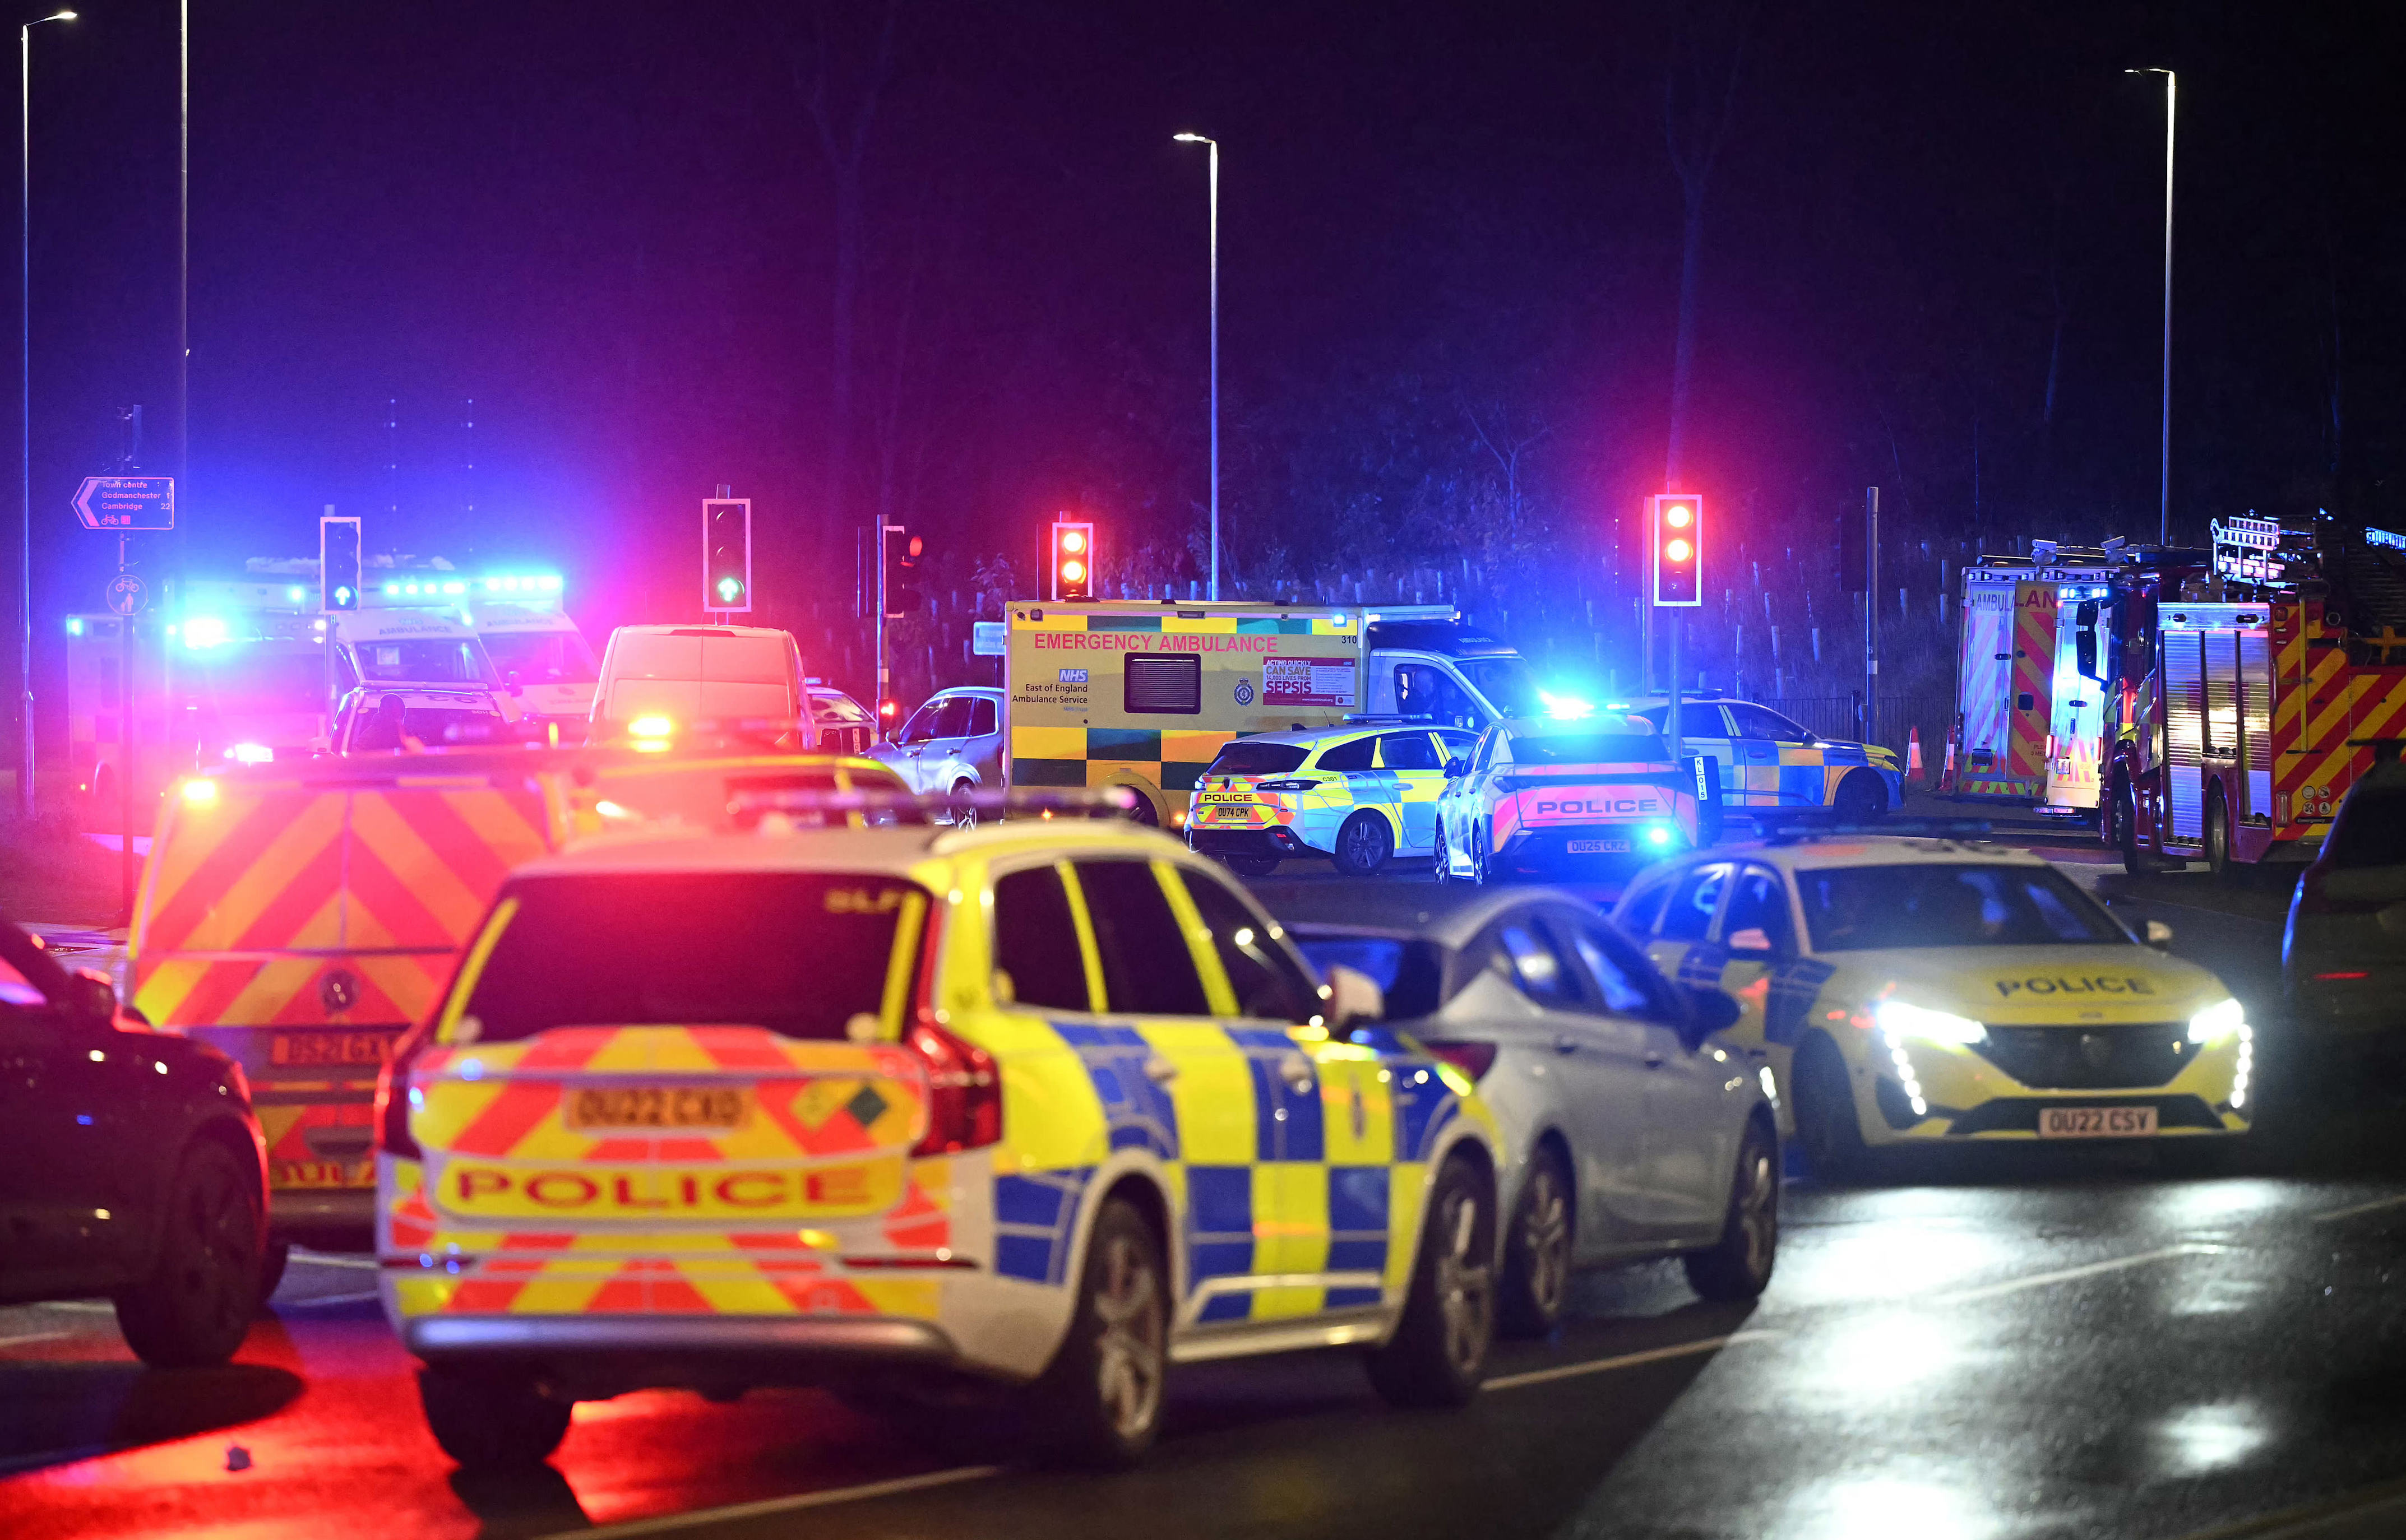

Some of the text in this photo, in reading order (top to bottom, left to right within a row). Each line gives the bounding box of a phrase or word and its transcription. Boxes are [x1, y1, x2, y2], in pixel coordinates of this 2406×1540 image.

[1035, 633, 1279, 652] EMERGENCY AMBULANCE
[1341, 636, 1357, 644] 310
[1059, 669, 1088, 681] NHS
[1266, 666, 1285, 675] CAN
[1288, 666, 1311, 675] SAVE
[1056, 684, 1088, 694] England
[1266, 681, 1311, 694] SEPSIS
[1218, 808, 1249, 817] OU74 CPK
[1537, 799, 1657, 814] POLICE
[1572, 842, 1625, 851] OU25 CRZ
[1996, 977, 2156, 998] POLICE
[2049, 1108, 2149, 1132] OU22 CSV
[459, 1168, 872, 1209] POLICE
